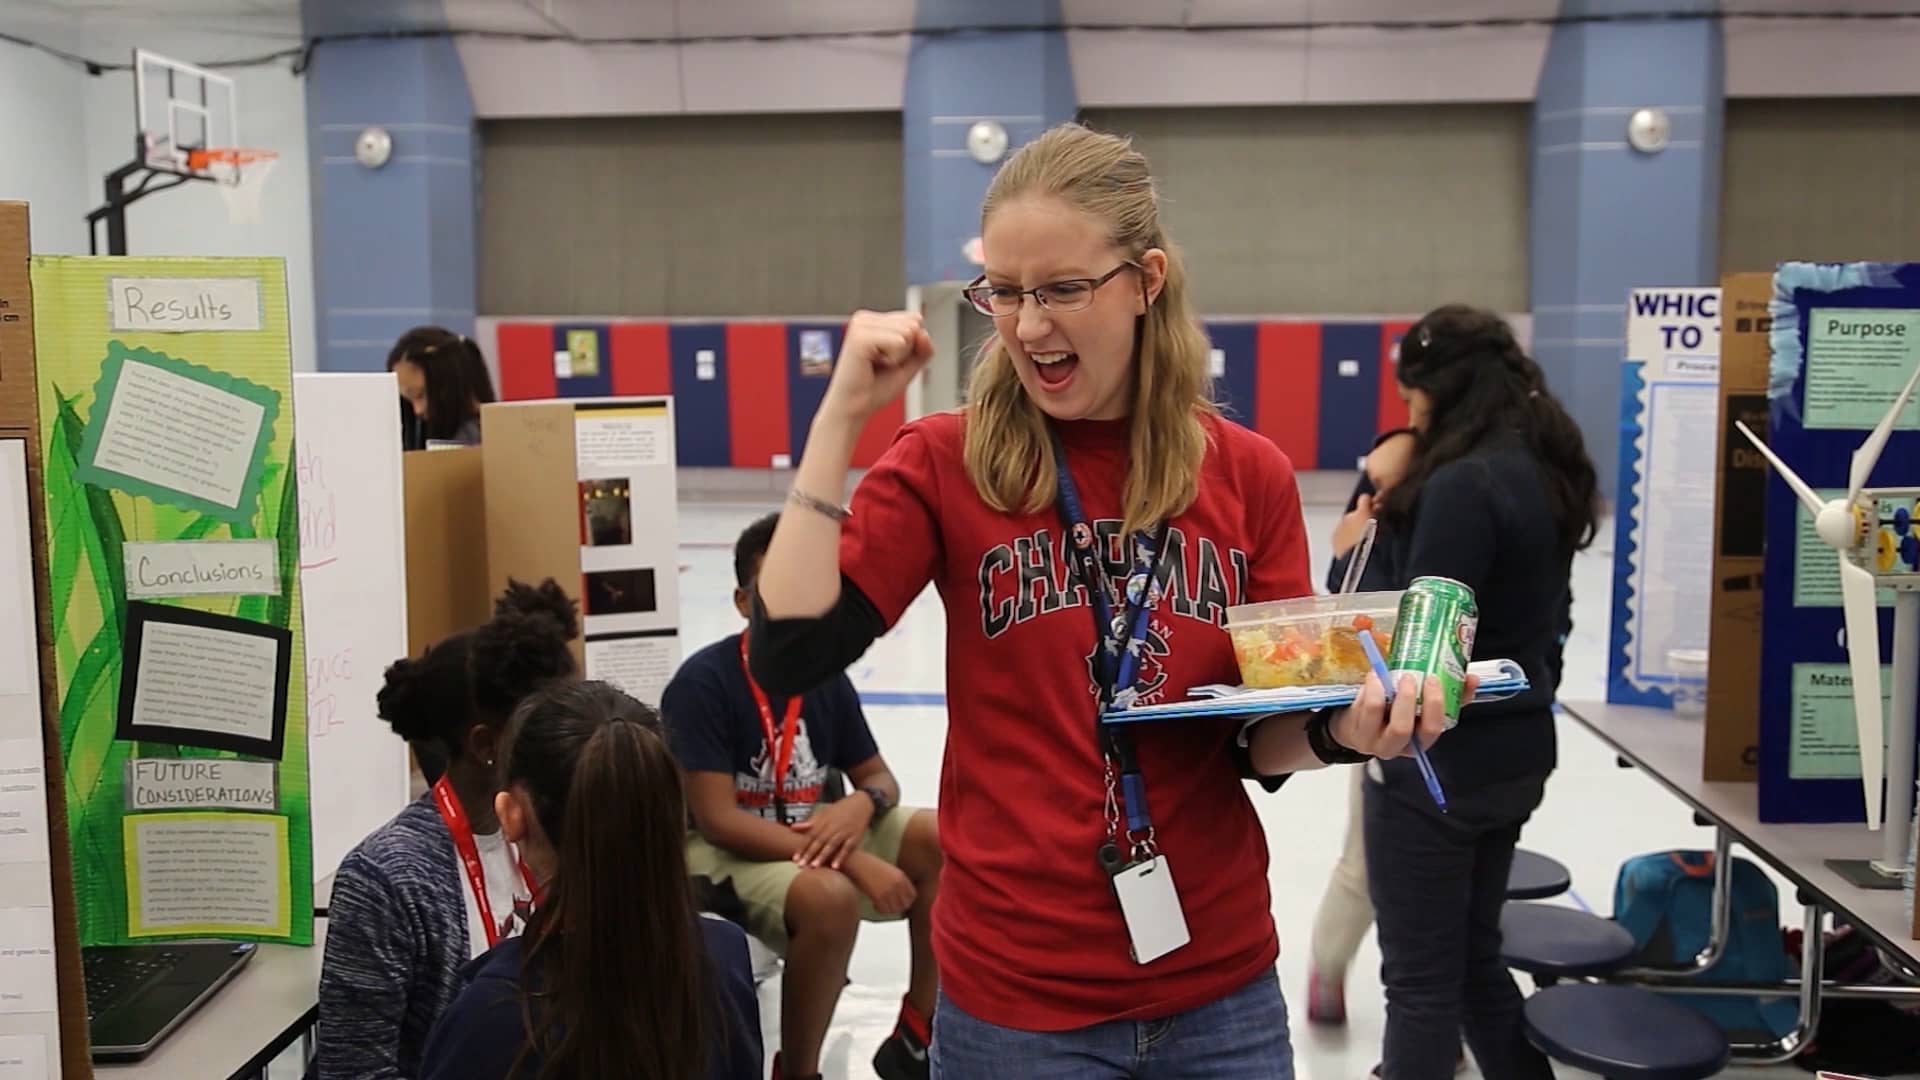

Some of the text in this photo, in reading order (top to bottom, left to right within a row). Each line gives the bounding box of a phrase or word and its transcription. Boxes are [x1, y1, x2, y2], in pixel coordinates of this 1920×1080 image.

[124, 286, 233, 323] Results
[1660, 325, 1702, 349] TO
[1827, 319, 1906, 340] Purpose
[138, 555, 264, 588] Conclusions
[136, 760, 222, 782] FUTURE
[136, 786, 273, 806] CONSIDERATIONS
